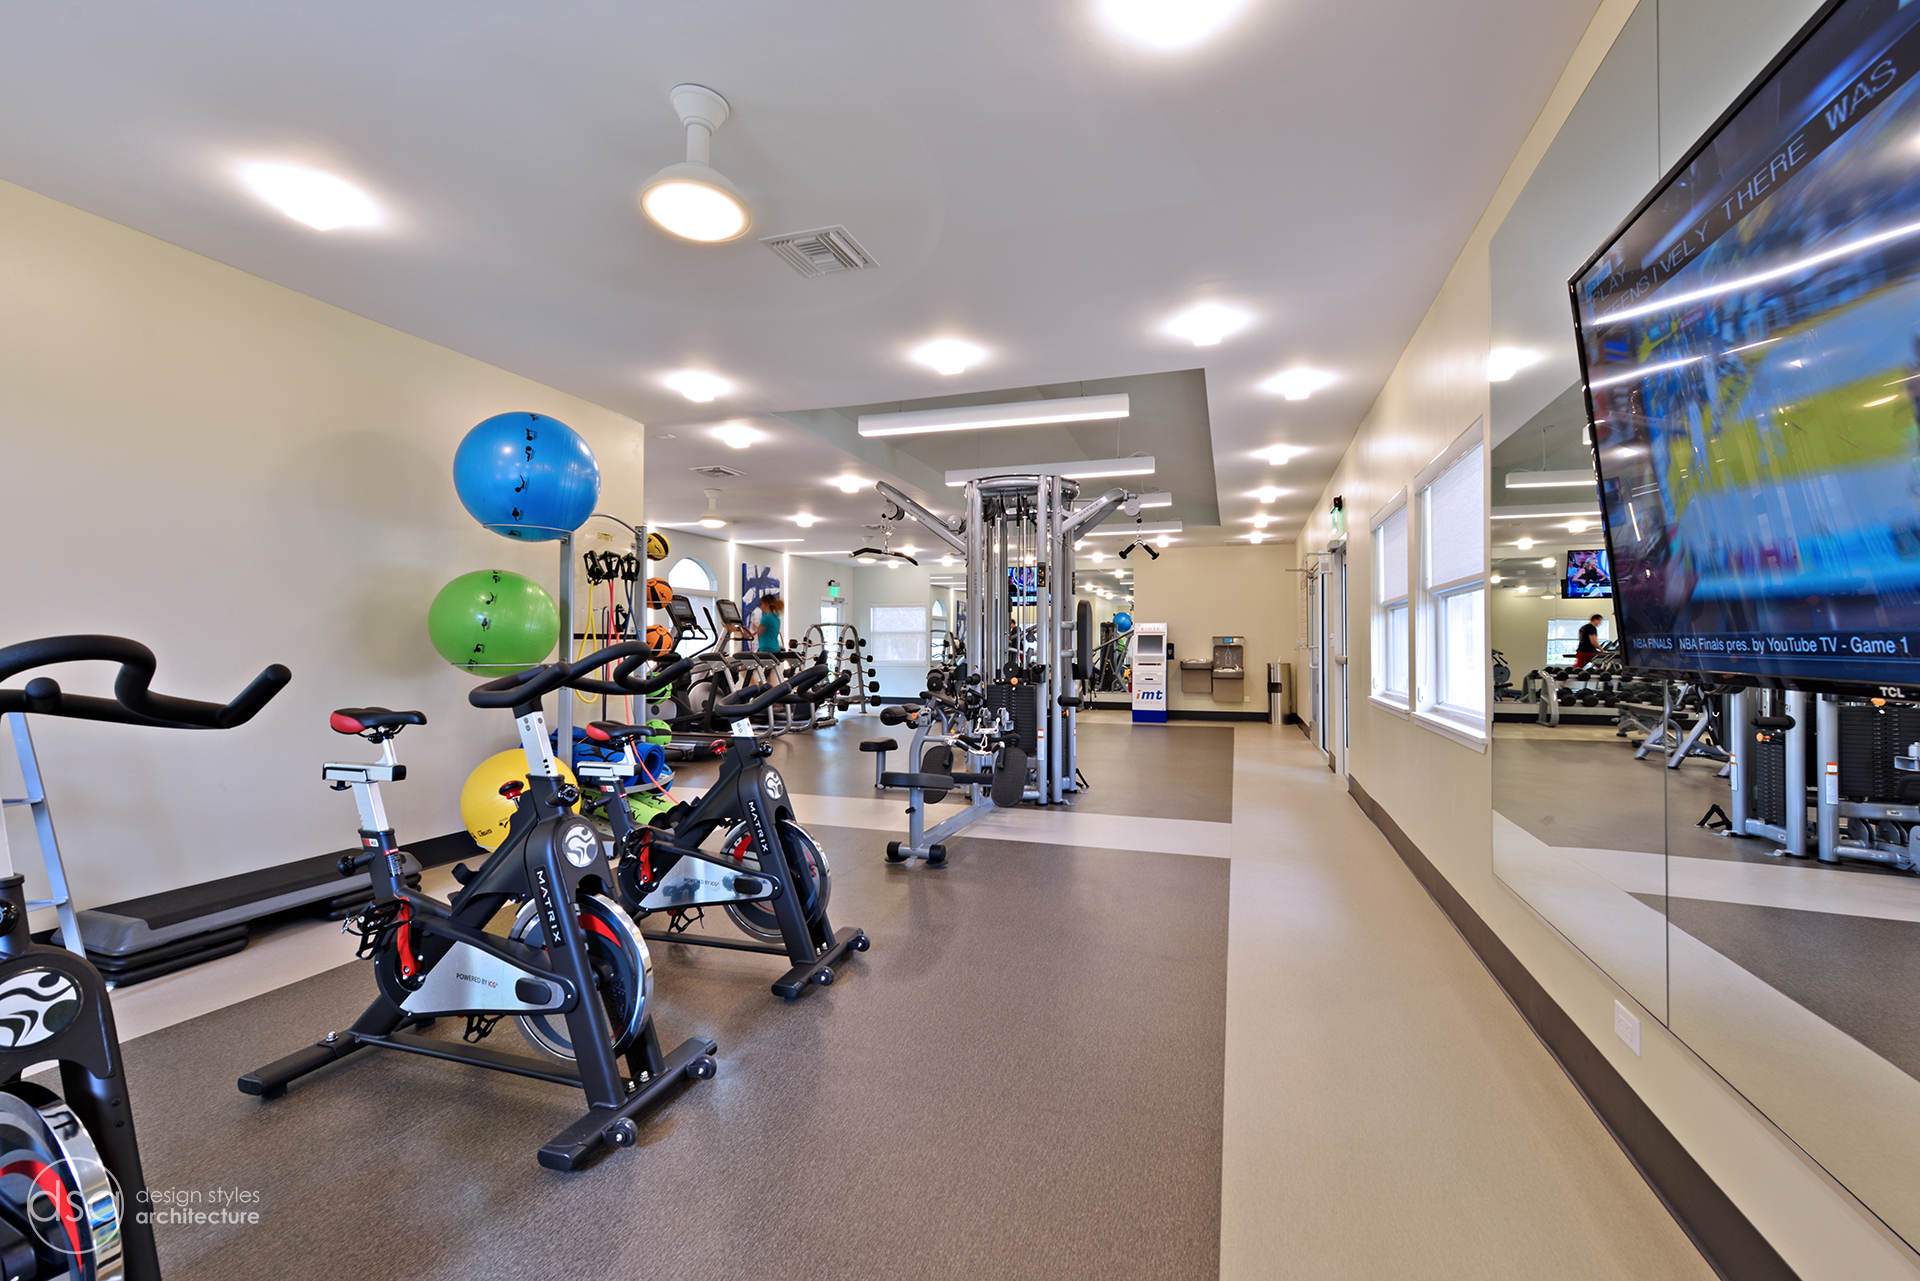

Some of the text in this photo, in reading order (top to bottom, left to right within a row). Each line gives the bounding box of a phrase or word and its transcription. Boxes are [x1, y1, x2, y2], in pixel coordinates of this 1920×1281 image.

[1721, 133, 1808, 220] THERE
[1825, 59, 1897, 131] WAS
[1633, 638, 1673, 650] NBA FINALS
[1679, 638, 1698, 650] NBA
[1699, 638, 1725, 651] Finals
[1726, 640, 1750, 654] pres.
[1752, 637, 1765, 655] by
[1766, 637, 1818, 652] YouTube
[1819, 636, 1838, 652] TV
[1850, 636, 1896, 653] Game
[1900, 636, 1909, 653] 1
[1136, 689, 1163, 700] imt
[1879, 686, 1906, 698] TCL
[749, 801, 768, 852] MATRIX
[536, 870, 561, 942] MATRIX
[456, 973, 481, 983] POWERED
